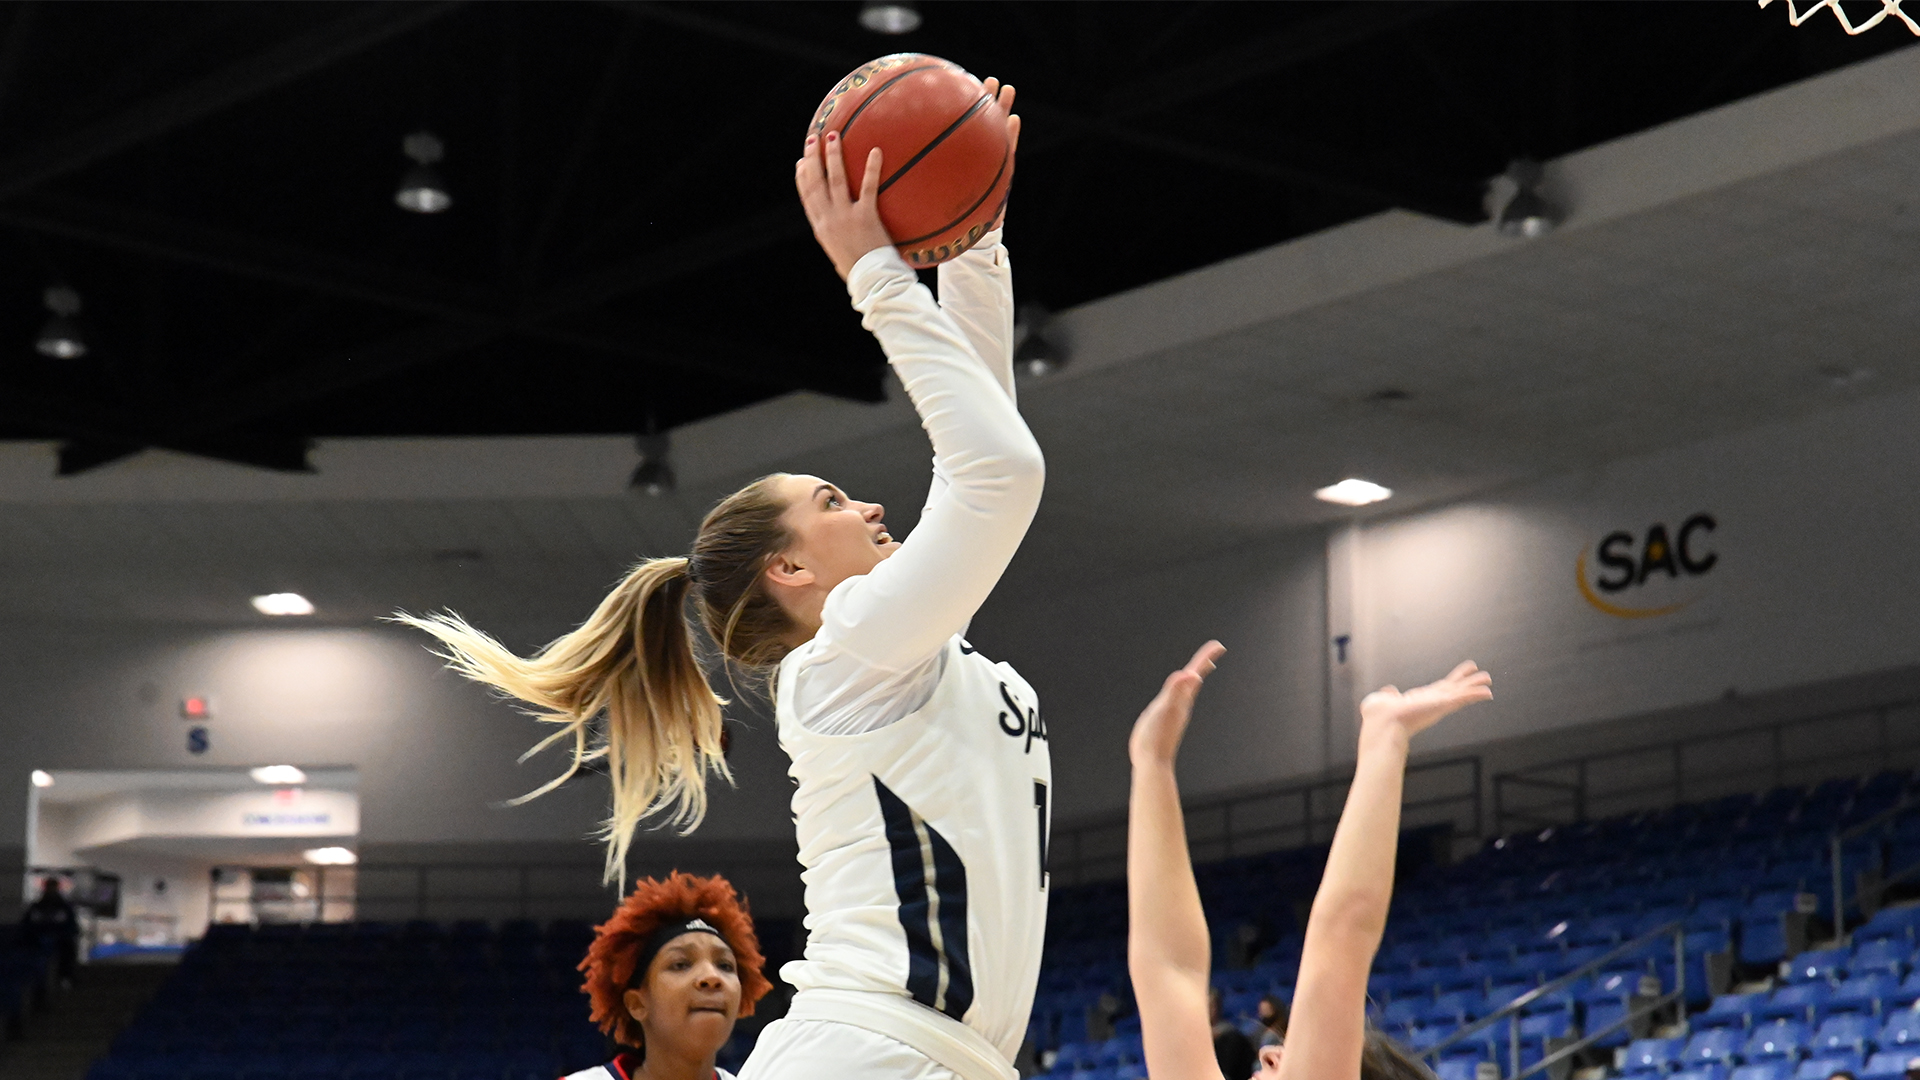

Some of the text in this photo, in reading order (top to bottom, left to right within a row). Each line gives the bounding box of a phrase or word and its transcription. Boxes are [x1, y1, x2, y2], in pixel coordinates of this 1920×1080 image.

[1597, 513, 1717, 593] SAC
[1333, 634, 1350, 664] T
[188, 727, 208, 754] S
